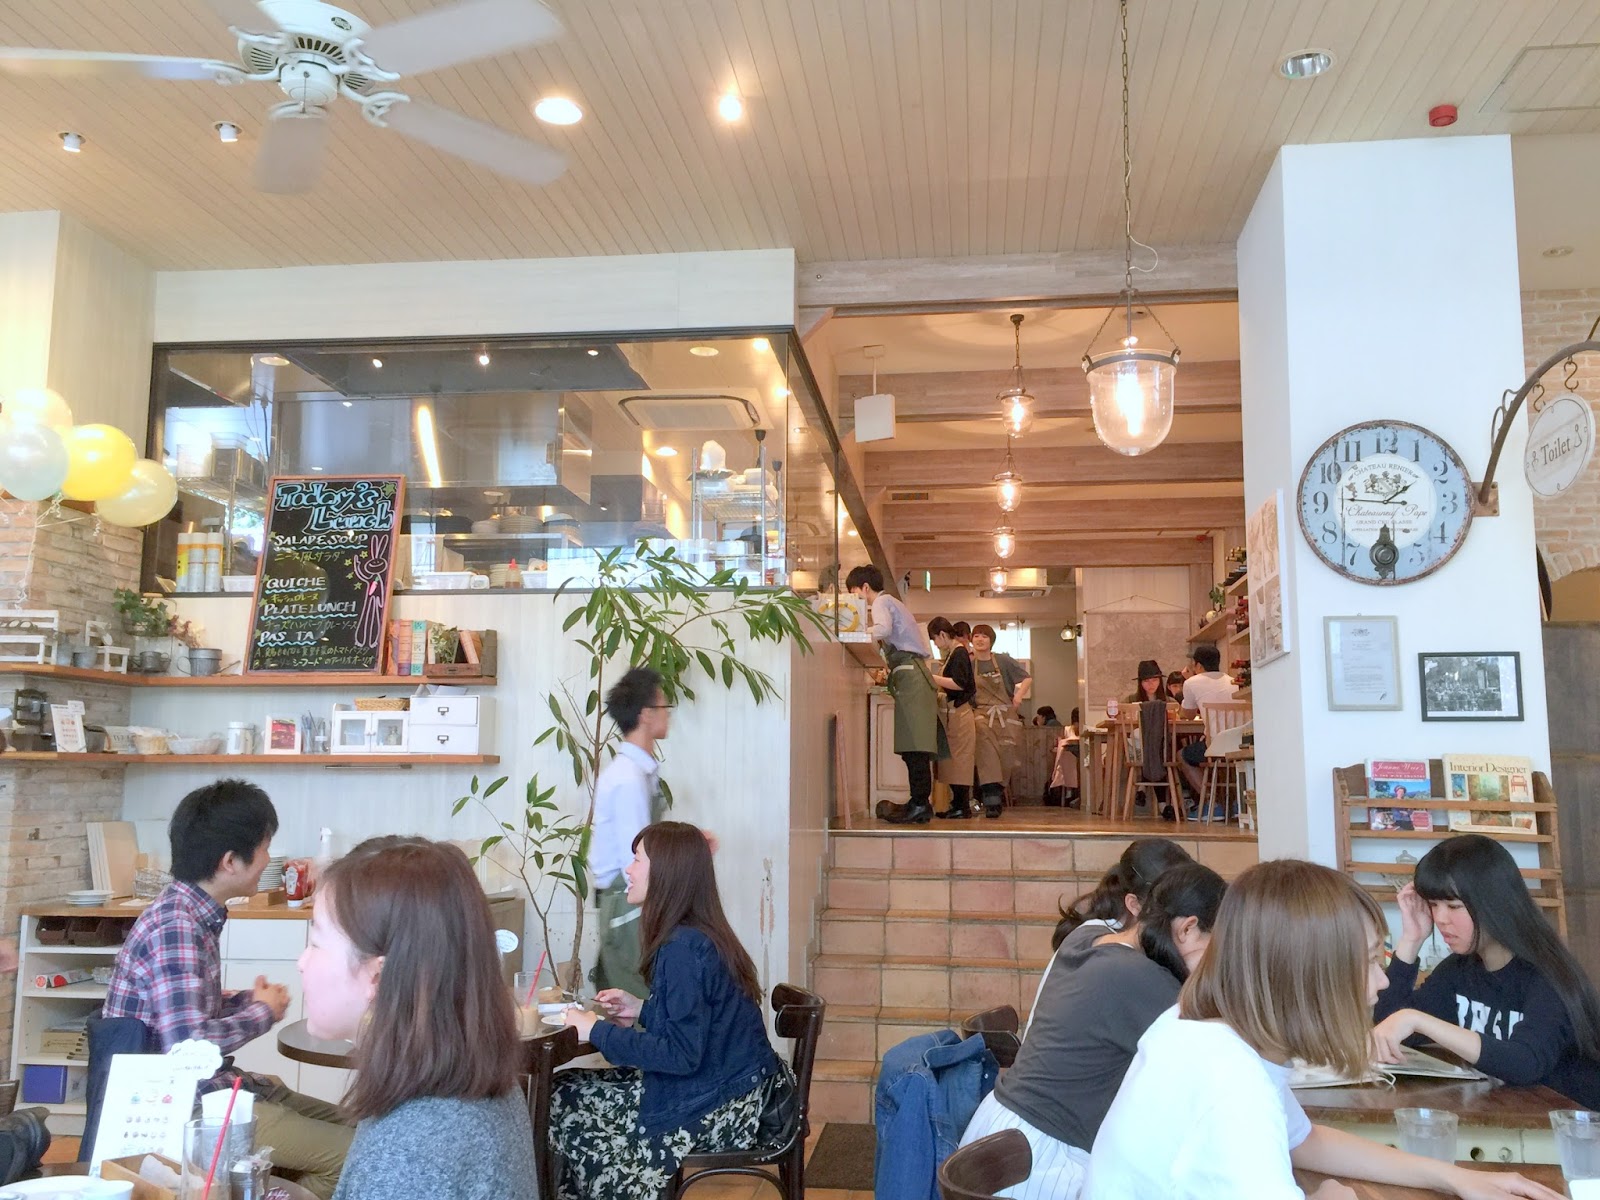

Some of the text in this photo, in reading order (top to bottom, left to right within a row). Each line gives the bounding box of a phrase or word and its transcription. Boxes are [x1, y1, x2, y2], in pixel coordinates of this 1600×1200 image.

[1342, 440, 1361, 462] 11
[1376, 431, 1398, 454] 12
[1410, 439, 1420, 462] 1
[1540, 436, 1571, 466] Toilet
[1320, 462, 1342, 484] 10
[1353, 463, 1387, 476] CHATEAU
[1433, 460, 1448, 484] 2
[276, 480, 380, 513] Today's
[1313, 491, 1329, 514] 9
[1442, 491, 1458, 514] 3
[307, 501, 394, 533] Lunch
[327, 533, 368, 546] SOUP
[1322, 521, 1337, 544] 8
[1433, 521, 1449, 544] 4
[1346, 543, 1360, 566] 7
[1409, 543, 1425, 566] 5
[266, 577, 326, 590] QUICHE
[264, 601, 356, 616] PLATE LUNCH
[1450, 762, 1528, 774] Interior Designer
